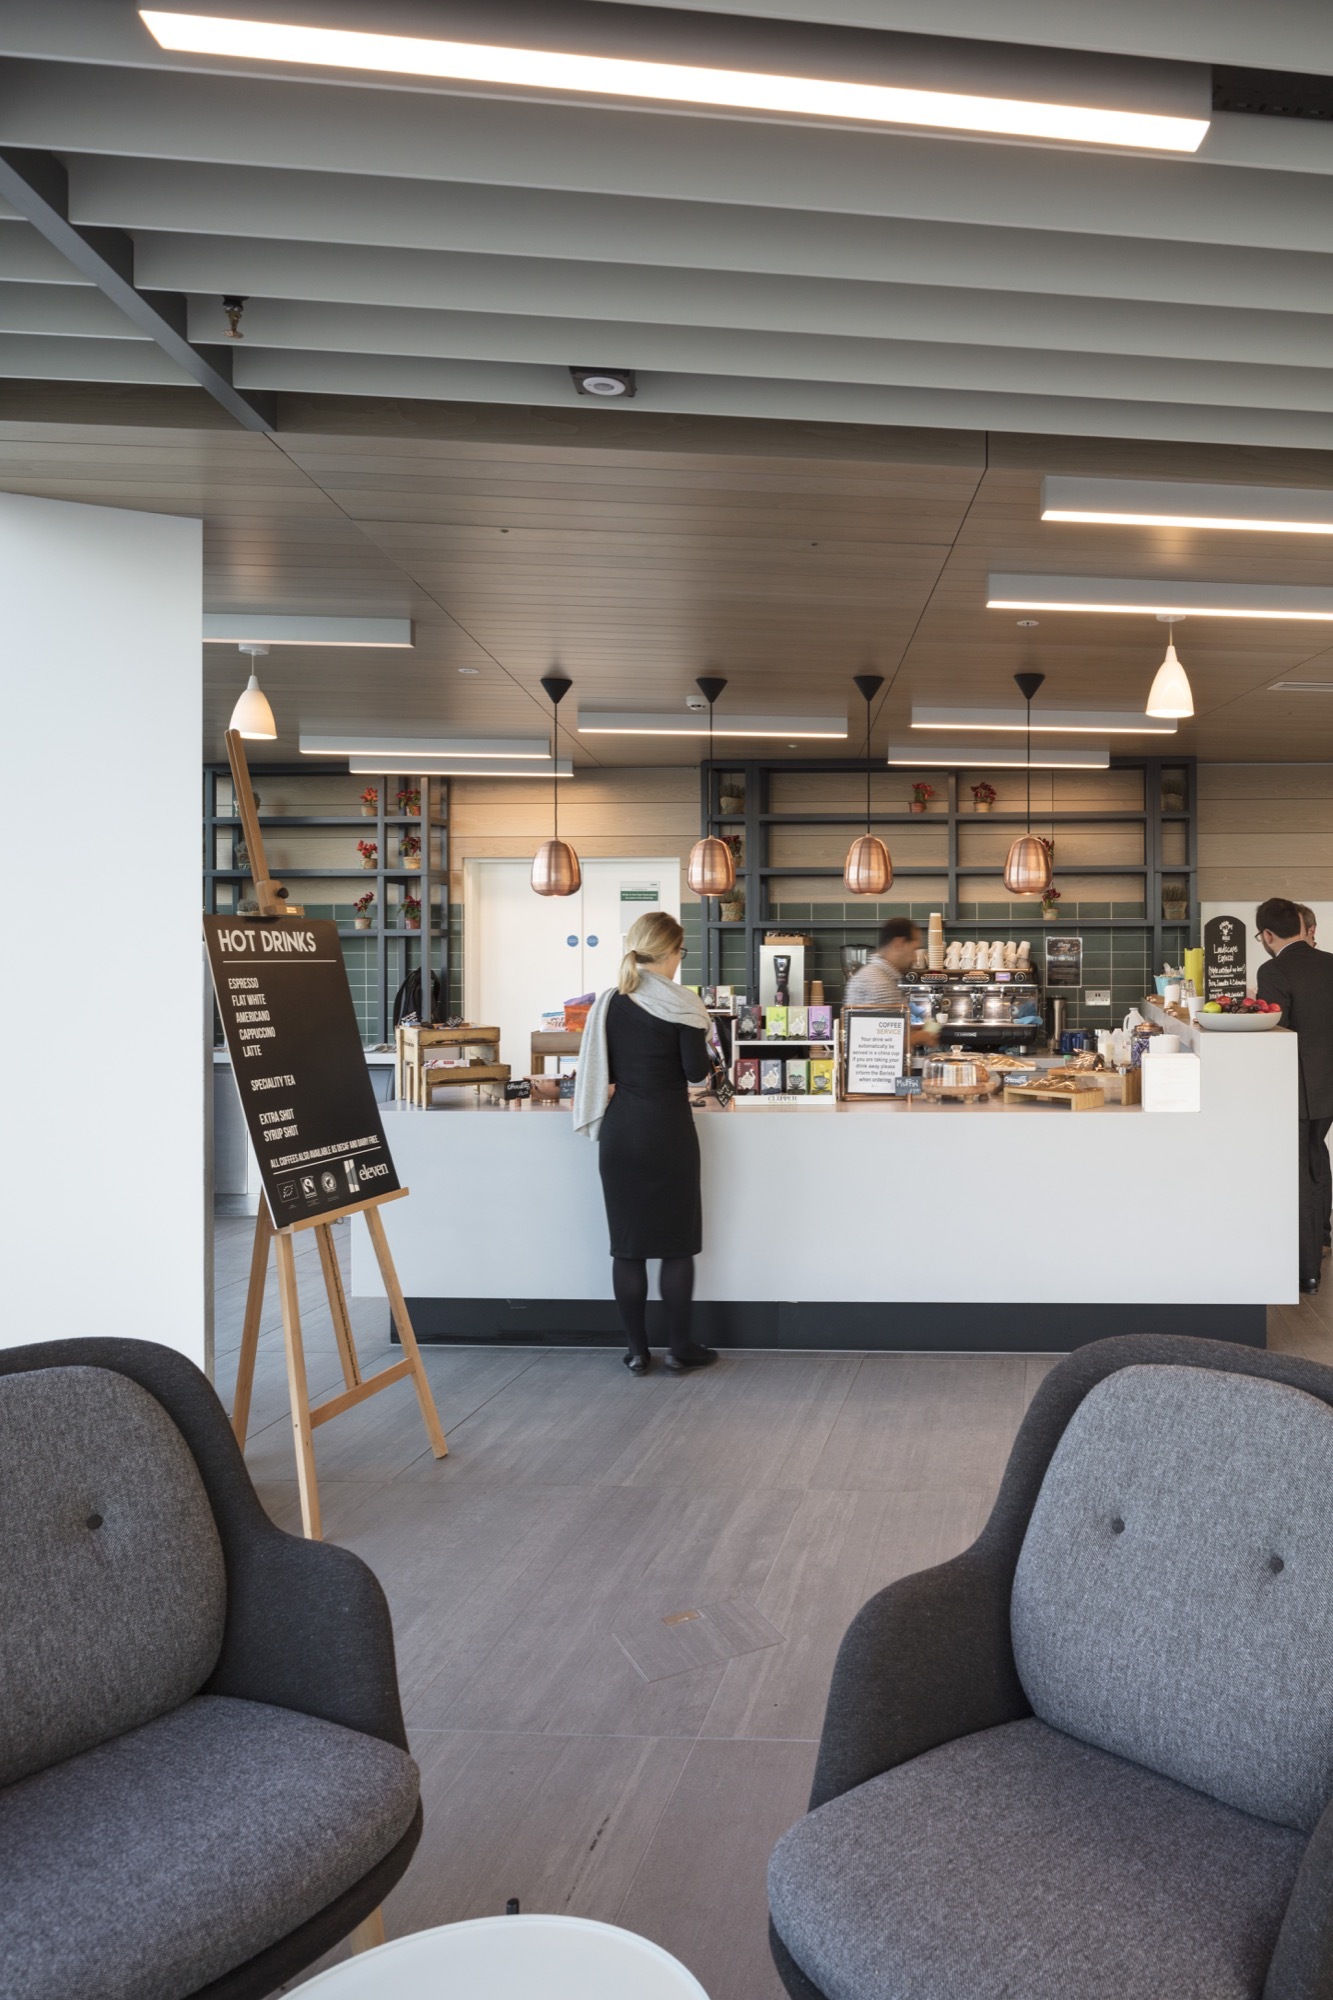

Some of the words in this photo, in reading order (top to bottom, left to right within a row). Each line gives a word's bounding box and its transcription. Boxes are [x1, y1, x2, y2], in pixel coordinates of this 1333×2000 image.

[217, 929, 256, 952] HOT
[260, 930, 317, 952] DRINKS
[228, 977, 259, 989] ESPRESSO
[231, 994, 247, 1006] FLAT
[247, 993, 267, 1005] WHITE
[235, 1010, 271, 1023] AMERICANO
[878, 1021, 902, 1029] COFFEE
[238, 1026, 276, 1040] CAPPUCCINO
[242, 1044, 263, 1057] LATTE
[250, 1076, 284, 1091] SPECIALITY
[283, 1074, 297, 1087] TEA
[259, 1111, 280, 1125] EXTRA
[279, 1108, 295, 1121] SHOT
[263, 1128, 284, 1142] SYRUP
[283, 1124, 299, 1138] SHOT
[270, 1158, 280, 1169] ALL
[279, 1153, 300, 1167] COFFEES
[298, 1150, 310, 1161] ALSO
[309, 1145, 333, 1159] AVAILABLE
[331, 1144, 338, 1154] AS
[337, 1141, 350, 1152] DECAF
[349, 1140, 358, 1149] AND
[359, 1162, 390, 1181] eleven
